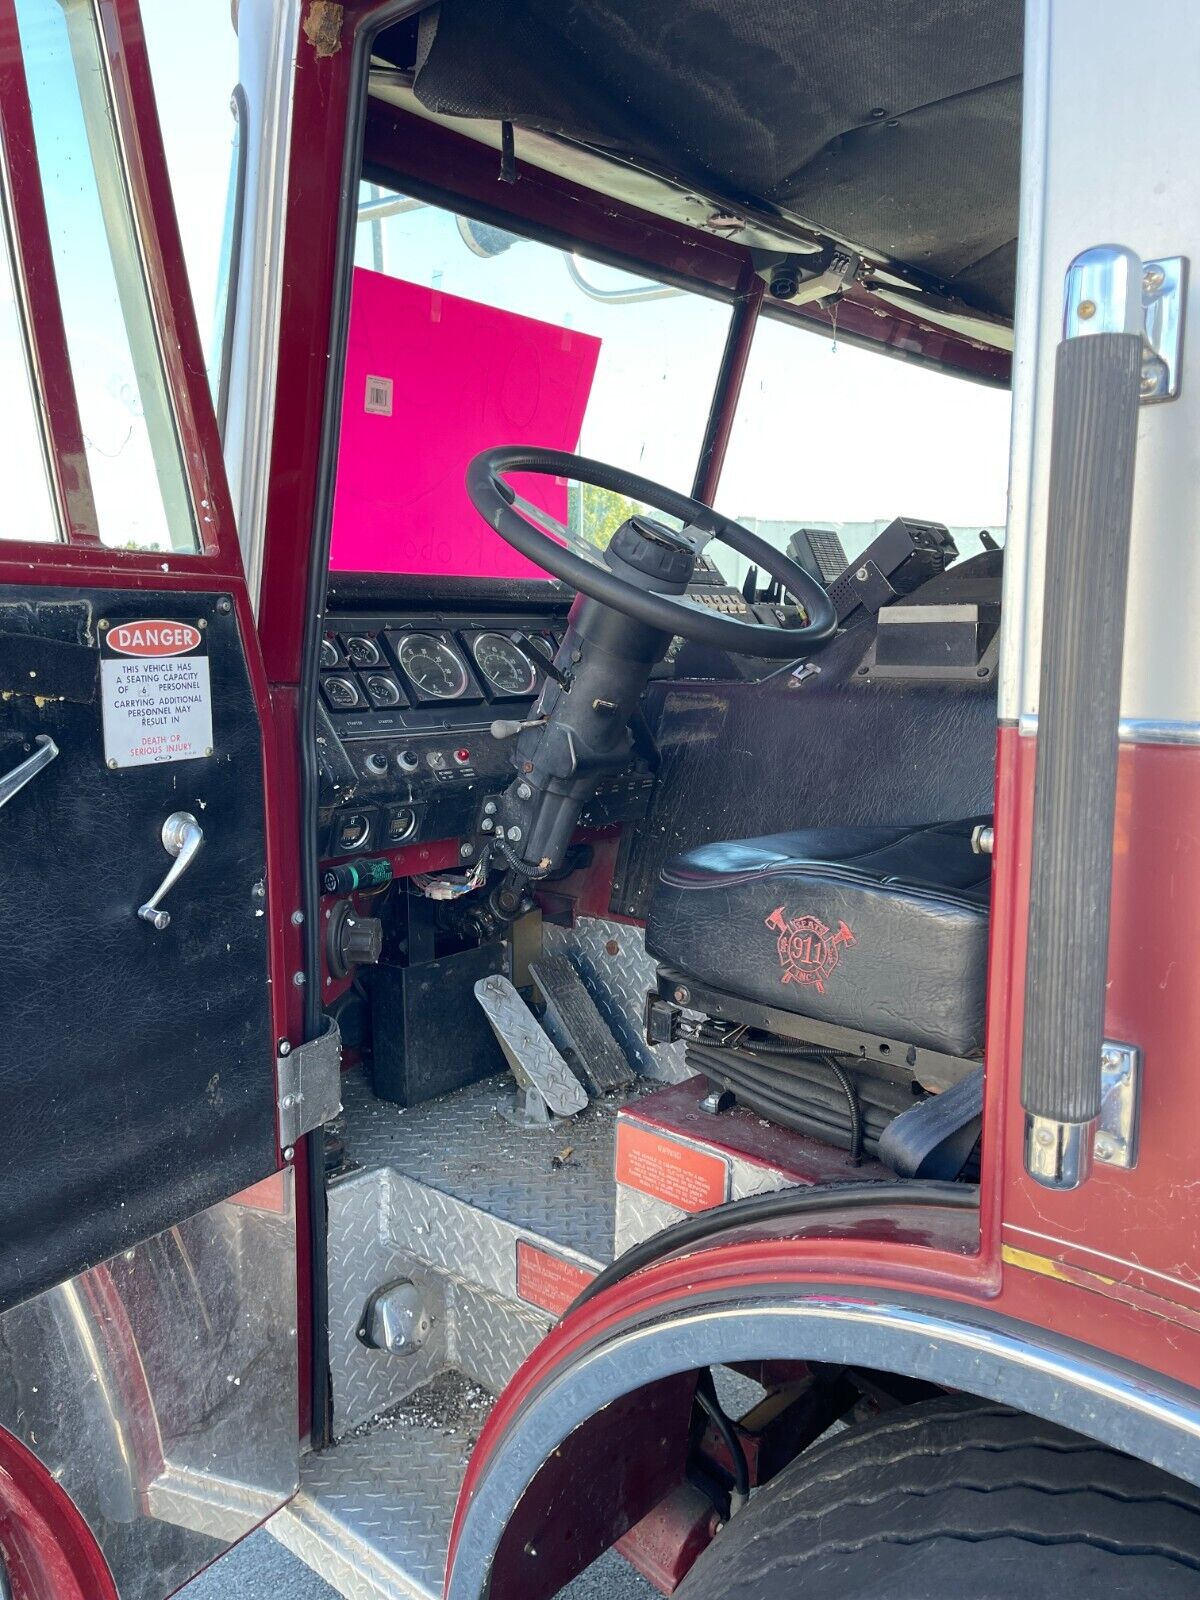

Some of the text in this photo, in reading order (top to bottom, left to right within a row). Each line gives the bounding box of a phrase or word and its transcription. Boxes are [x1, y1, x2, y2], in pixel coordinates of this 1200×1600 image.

[118, 629, 193, 647] DANGER
[143, 664, 173, 672] VEHICLE
[163, 673, 198, 681] CAPACITY
[118, 685, 129, 694] OF
[114, 695, 202, 708] CARRYING ADDITIONAL
[128, 708, 171, 717] PERSONNEL
[130, 743, 192, 756] SERIOUS INJURY
[792, 936, 821, 964] 911
